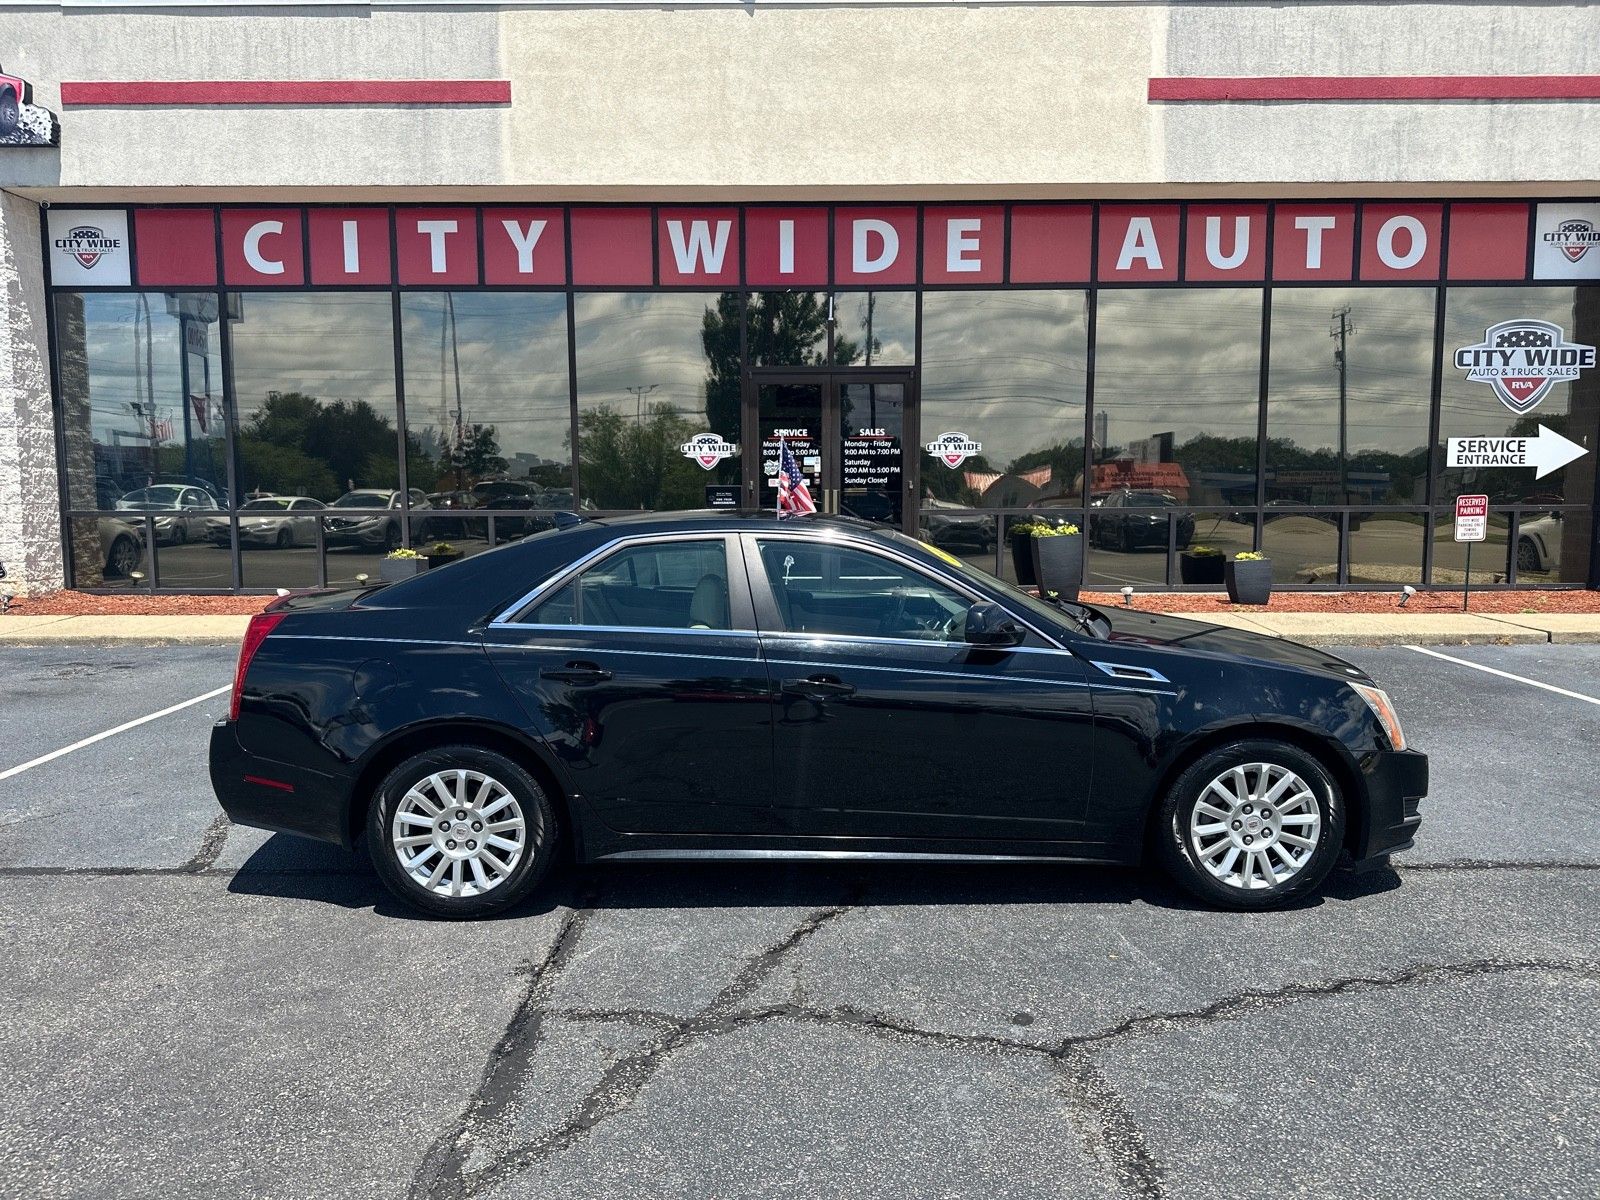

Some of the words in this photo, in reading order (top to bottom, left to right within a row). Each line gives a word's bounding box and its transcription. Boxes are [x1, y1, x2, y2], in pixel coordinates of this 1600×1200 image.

[1543, 233, 1572, 241] CITY
[1576, 233, 1600, 241] WID
[55, 239, 83, 248] CITY
[87, 239, 121, 248] WIDE
[243, 220, 548, 275] CITY
[666, 219, 982, 274] WIDE
[1115, 215, 1427, 270] AUTO
[1457, 349, 1516, 367] CITY
[1524, 349, 1594, 366] WIDE
[1470, 368, 1499, 376] AUTO
[1500, 368, 1509, 376] &
[1512, 368, 1544, 376] TRUCK
[1547, 367, 1578, 376] SALES
[1511, 381, 1534, 389] RVA
[859, 428, 886, 437] SALES
[681, 444, 705, 452] CITY
[708, 444, 736, 452] WIDE
[791, 440, 810, 448] Friday
[844, 440, 869, 448] Monday
[873, 440, 892, 448] Friday
[926, 443, 950, 451] CITY
[953, 443, 981, 451] WIDE
[1457, 440, 1527, 453] SERVICE
[844, 448, 858, 456] 9:00
[844, 458, 871, 467] Saturday
[1456, 454, 1526, 465] ENTRANCE
[844, 477, 867, 485] Sunday
[1459, 498, 1486, 506] RESERVED
[1460, 506, 1483, 515] PARKING
